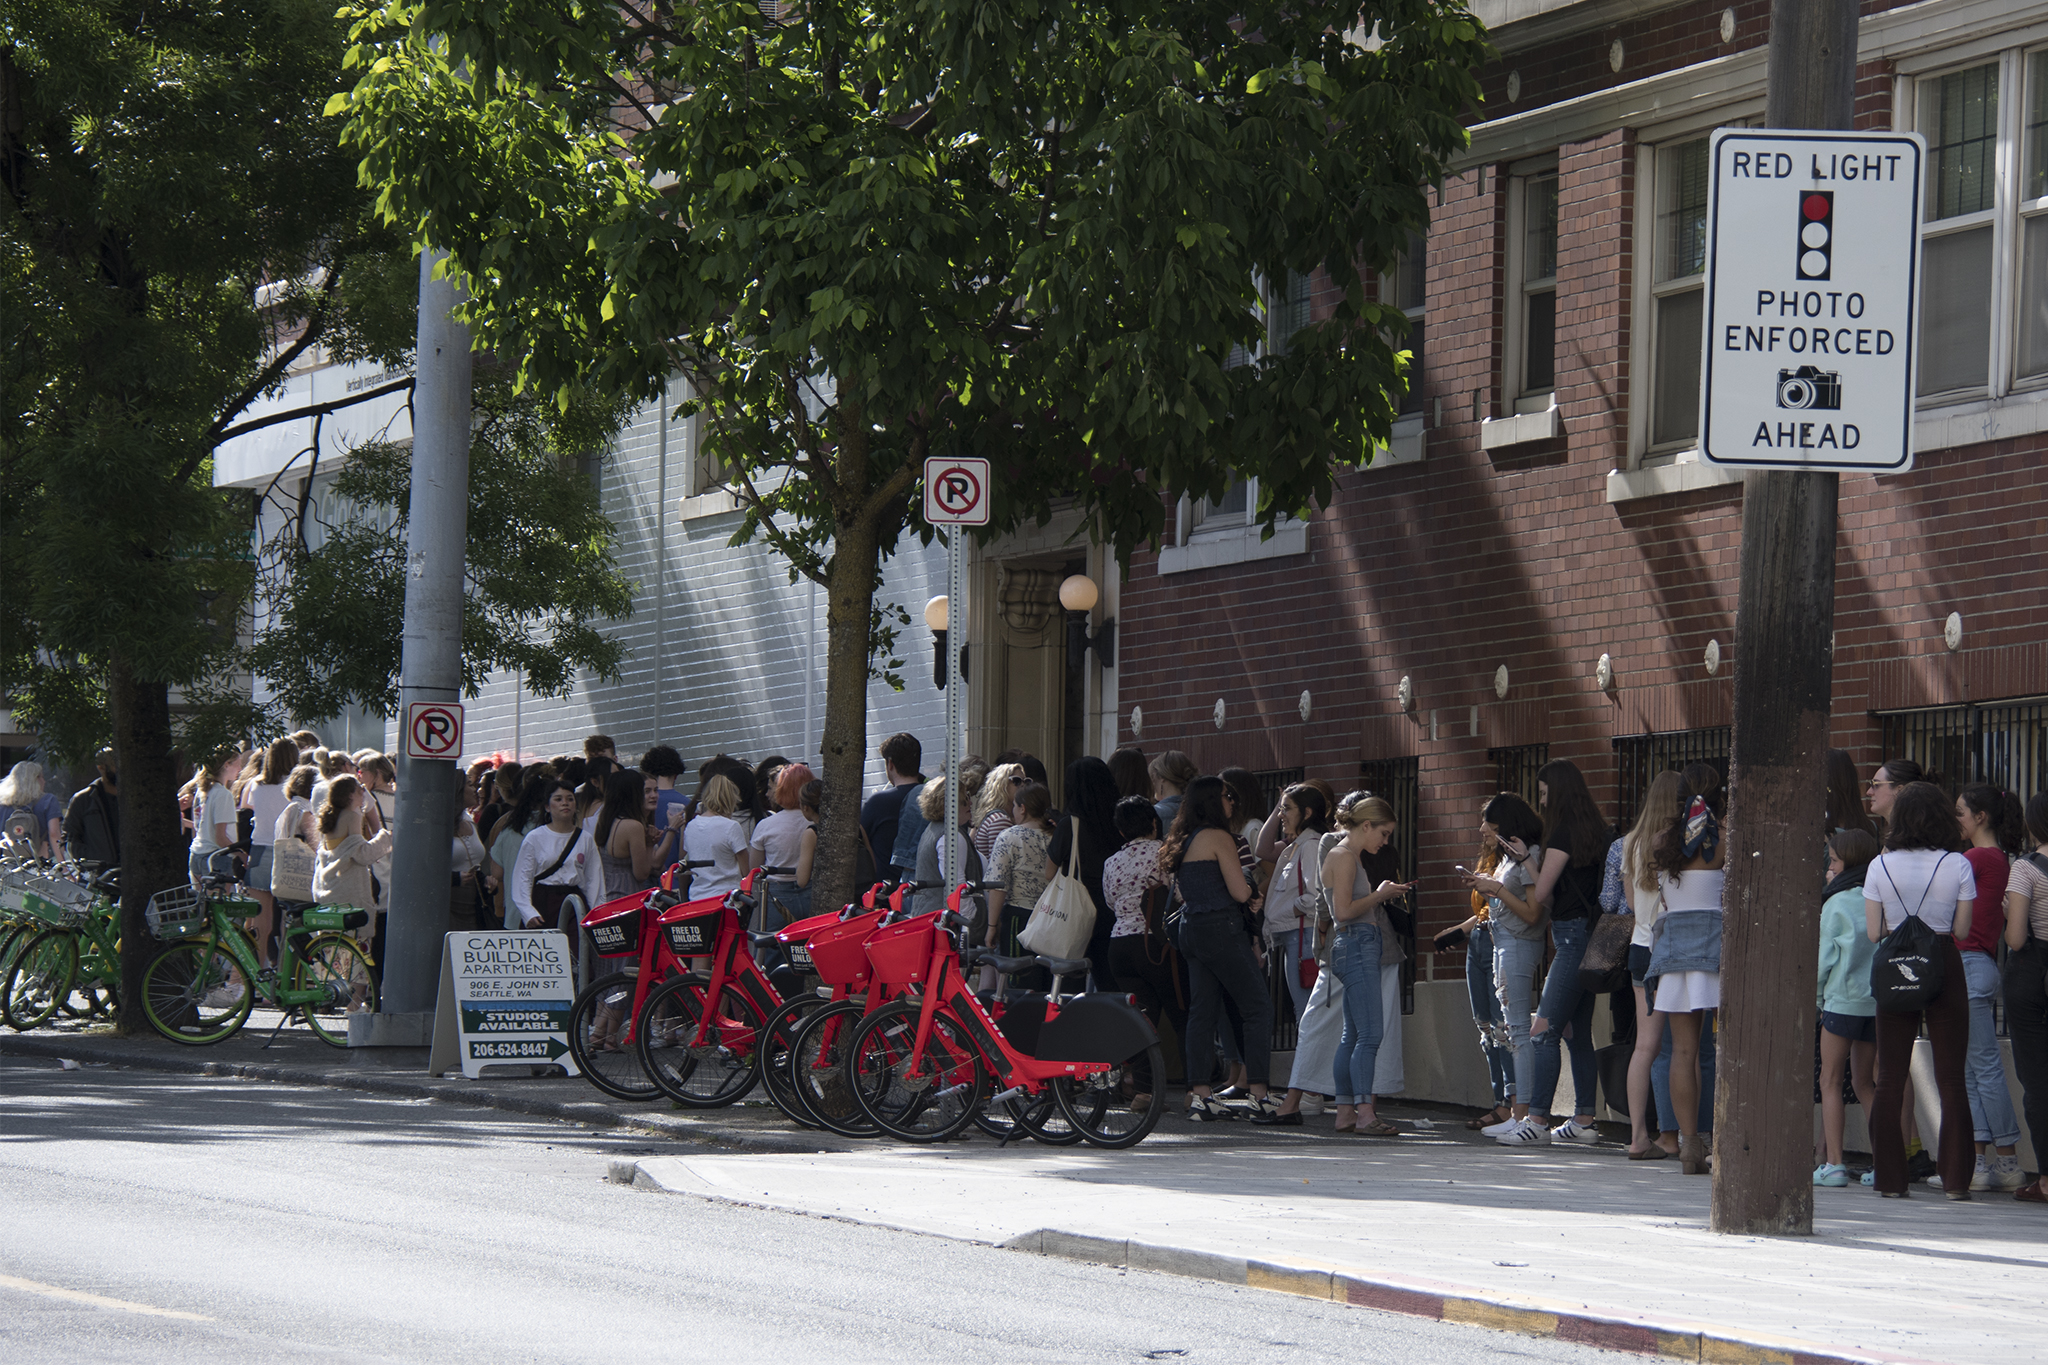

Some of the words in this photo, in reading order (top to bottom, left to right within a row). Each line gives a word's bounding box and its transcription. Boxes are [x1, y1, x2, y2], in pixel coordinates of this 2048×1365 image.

[1732, 151, 1793, 179] RED
[1811, 153, 1902, 182] LIGHT
[1757, 290, 1865, 319] PHOTO
[1725, 325, 1895, 356] ENFORCED
[1752, 421, 1861, 450] AHEAD
[592, 927, 611, 937] FREE
[610, 925, 622, 934] TO
[671, 926, 689, 935] FREE
[689, 926, 700, 934] TO
[595, 933, 625, 944] UNLOCK
[672, 934, 703, 943] UNLOCK
[467, 938, 553, 950] CAPITAL
[790, 945, 808, 954] FREE
[463, 951, 559, 963] BUILDING
[462, 964, 564, 974] APARTMENTS
[469, 981, 489, 989] 906
[492, 981, 504, 989] E.
[507, 981, 539, 989] JOHN
[542, 980, 560, 989] ST.
[469, 990, 514, 998] SEATTLE,
[486, 1012, 549, 1021] STUDIOS
[478, 1021, 559, 1031] AVAILABLE
